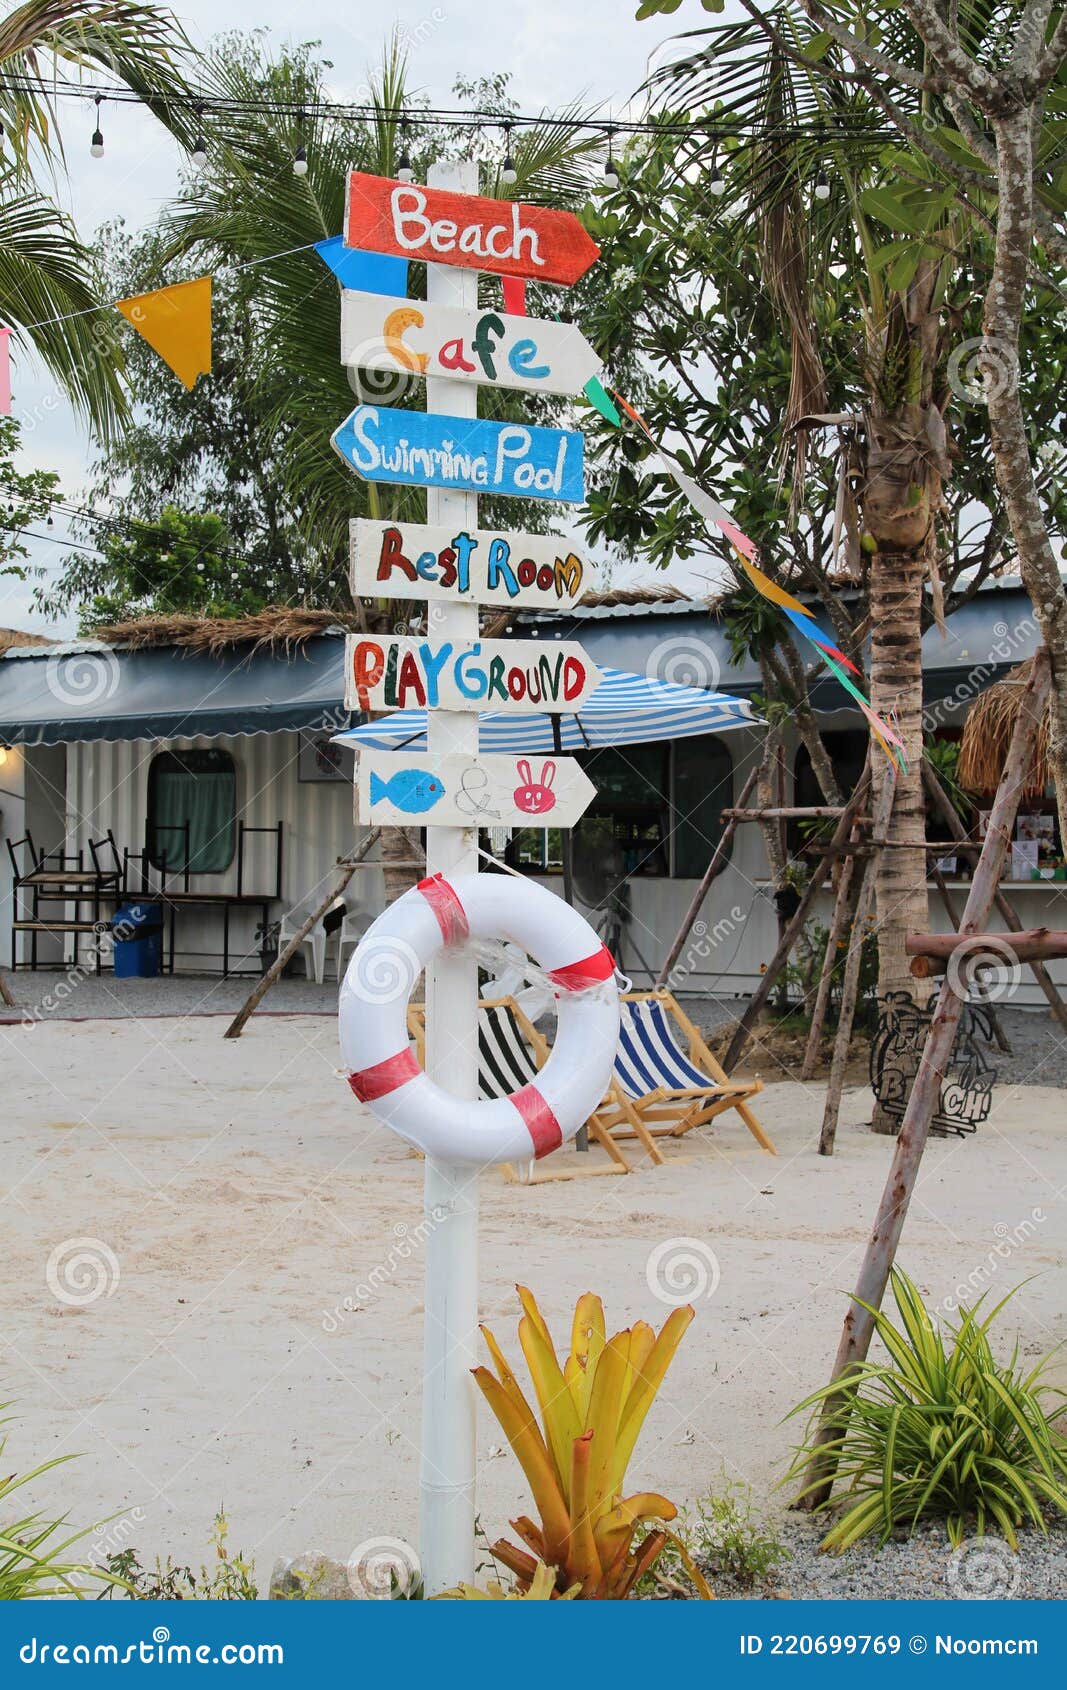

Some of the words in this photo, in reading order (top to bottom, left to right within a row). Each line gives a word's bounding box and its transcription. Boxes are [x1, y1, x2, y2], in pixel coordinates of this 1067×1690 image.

[391, 188, 545, 265] Beach
[383, 308, 551, 380] Cafe
[494, 426, 567, 494] Pool
